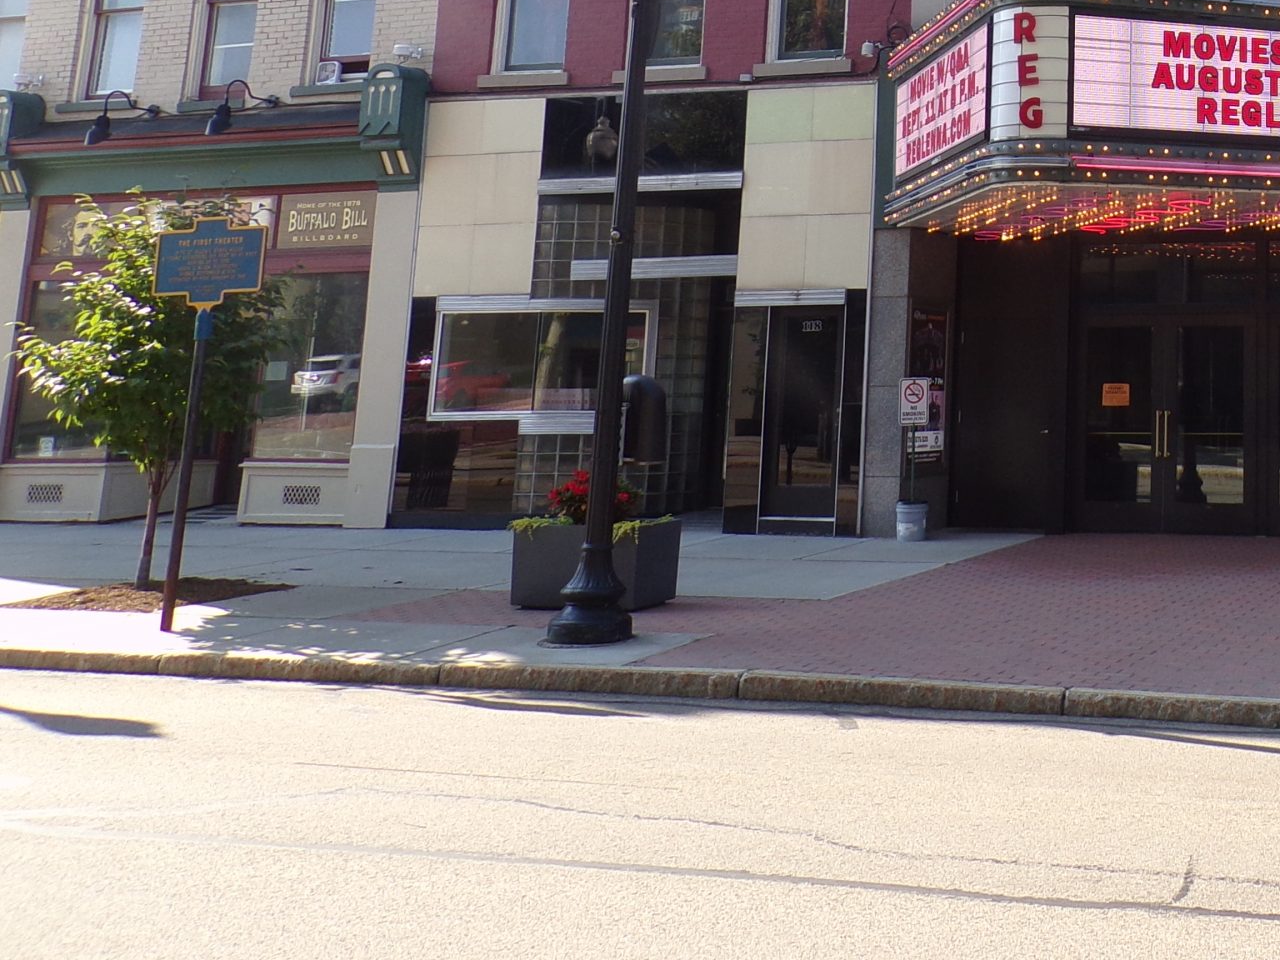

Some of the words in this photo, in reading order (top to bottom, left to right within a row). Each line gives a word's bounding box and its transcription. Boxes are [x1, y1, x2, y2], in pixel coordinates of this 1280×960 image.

[910, 66, 935, 104] MOVIE
[936, 42, 970, 88] W/Q&A
[902, 111, 923, 138] SEPT.
[925, 100, 936, 126] 11
[938, 89, 948, 117] AT
[959, 71, 979, 103] P.M.
[906, 108, 971, 167] REGLENNA.COM
[292, 233, 359, 242] BILLBOARD
